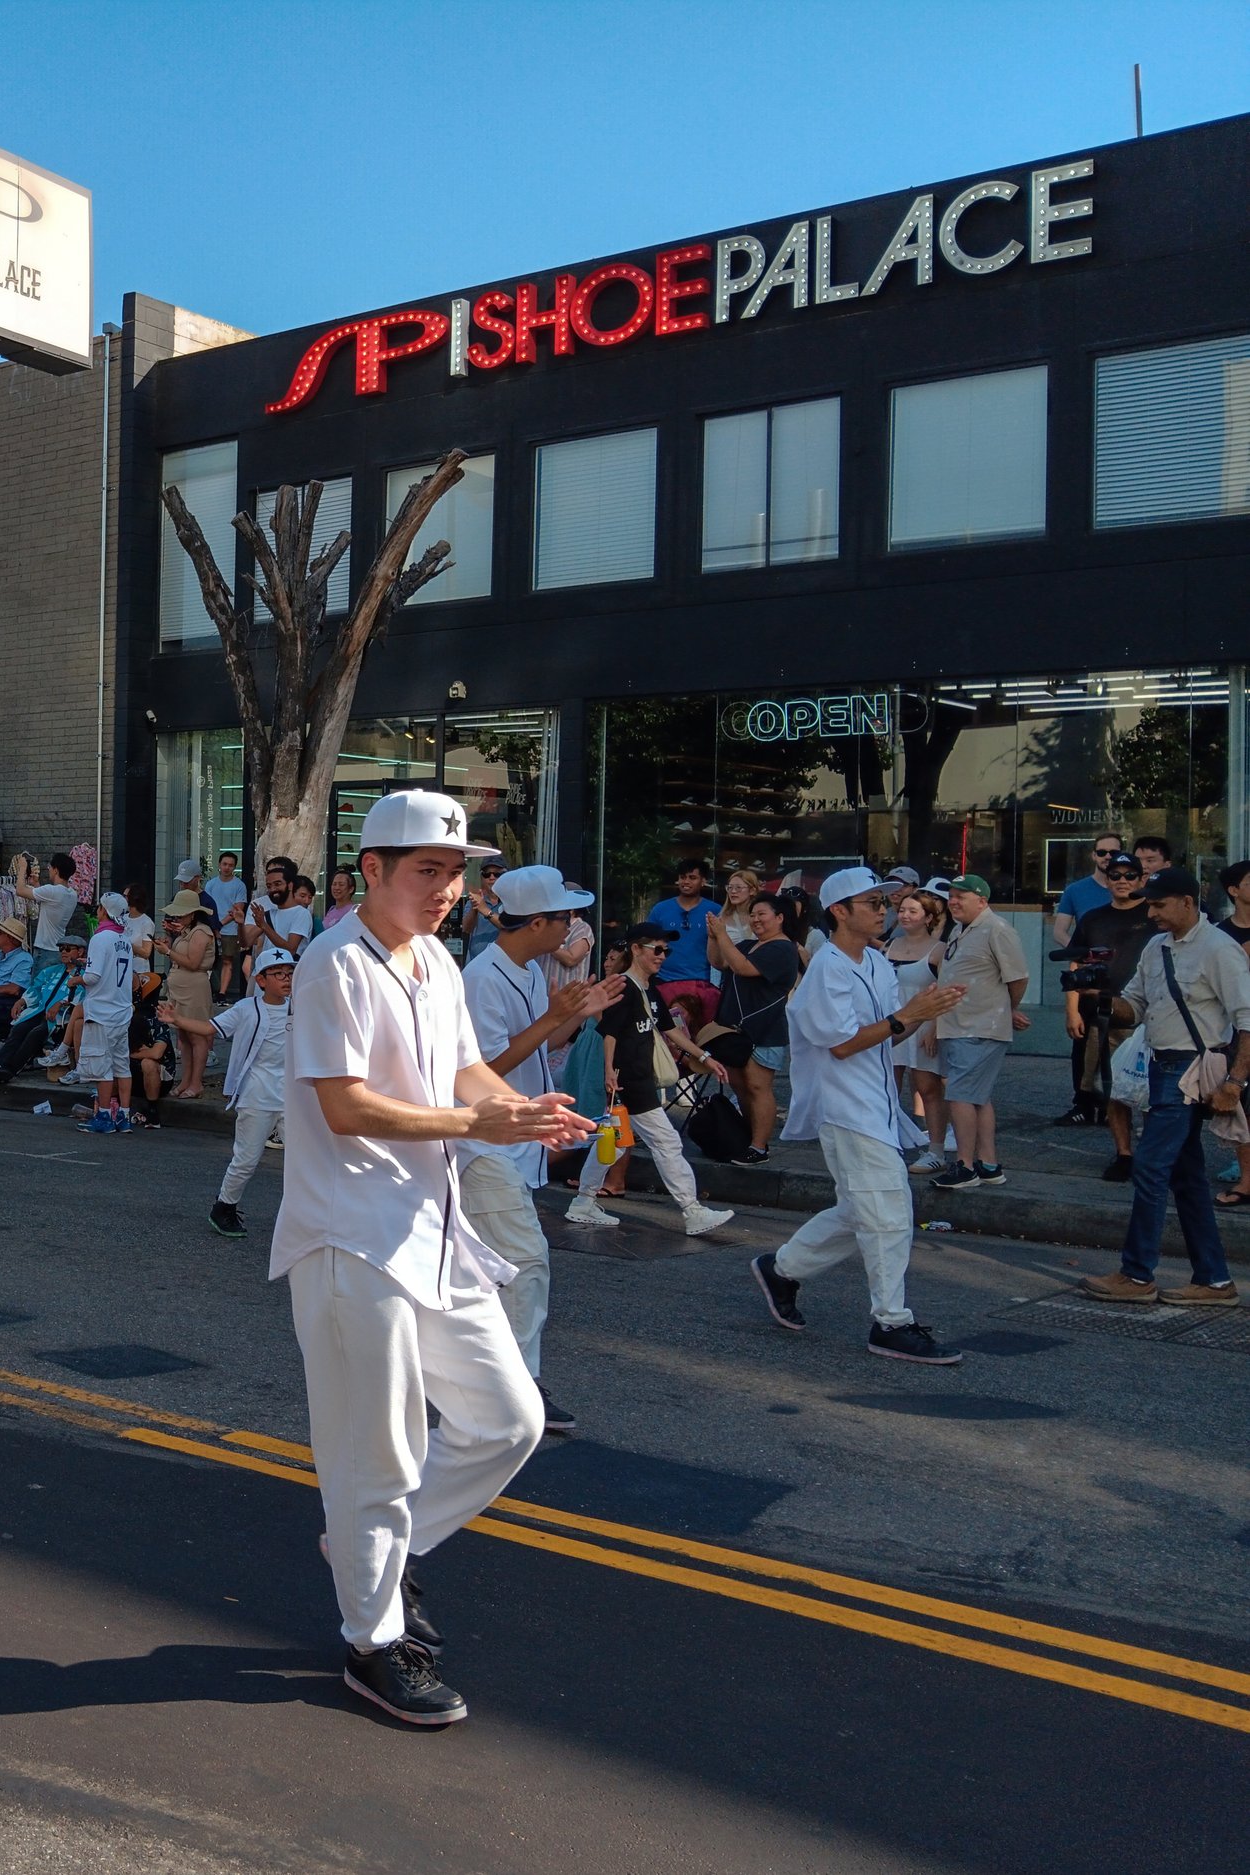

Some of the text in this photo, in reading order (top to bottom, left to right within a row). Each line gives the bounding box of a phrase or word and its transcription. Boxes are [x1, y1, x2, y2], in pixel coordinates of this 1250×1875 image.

[467, 243, 711, 369] SHOE
[715, 158, 1095, 324] PALACE
[747, 694, 888, 742] OPEN
